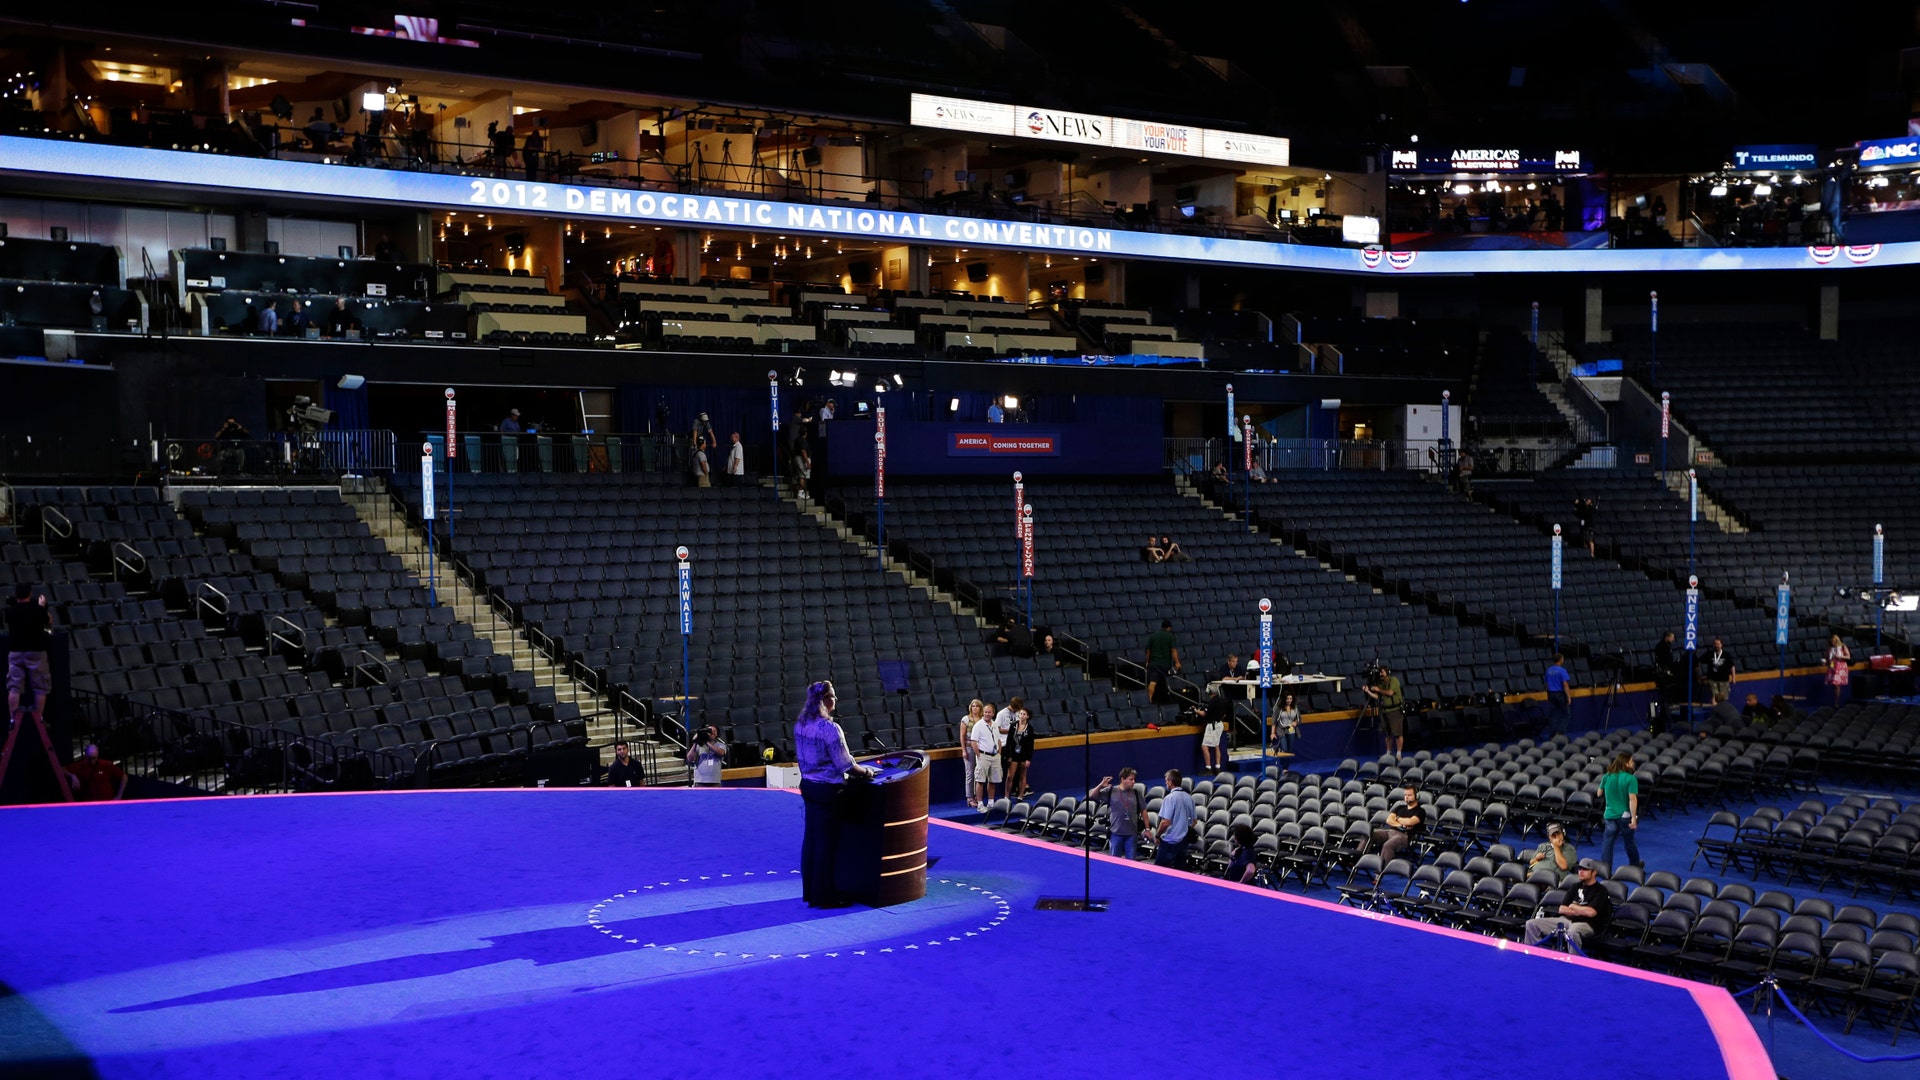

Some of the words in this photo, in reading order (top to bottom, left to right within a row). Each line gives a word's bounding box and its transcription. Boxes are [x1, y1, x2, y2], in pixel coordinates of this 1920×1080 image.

[1046, 114, 1102, 141] NEWS
[1144, 124, 1165, 138] YOUR
[1166, 127, 1188, 141] VOICE
[1144, 136, 1165, 150] YOUR
[1167, 138, 1188, 152] VOTE
[1451, 149, 1519, 160] AMERICA'S
[1752, 153, 1814, 162] TELEMUNDO
[1885, 143, 1918, 158] NBC
[469, 181, 549, 211] 2012
[566, 186, 773, 225] DEMOCRATIC
[788, 206, 934, 239] NATIONAL
[945, 219, 1112, 252] CONVENTION
[771, 386, 779, 431] UTAH
[448, 406, 456, 457] MISSISSIPPI
[424, 463, 432, 517] OHIO
[1024, 523, 1032, 576] PENNSYLVANIA
[1553, 541, 1561, 588] OREGON
[681, 570, 690, 633] HAWAII
[1686, 595, 1696, 649] NEVADA
[1778, 592, 1787, 642] IOWA
[1262, 622, 1271, 647] NORTH
[1262, 648, 1271, 687] CAROLINA
